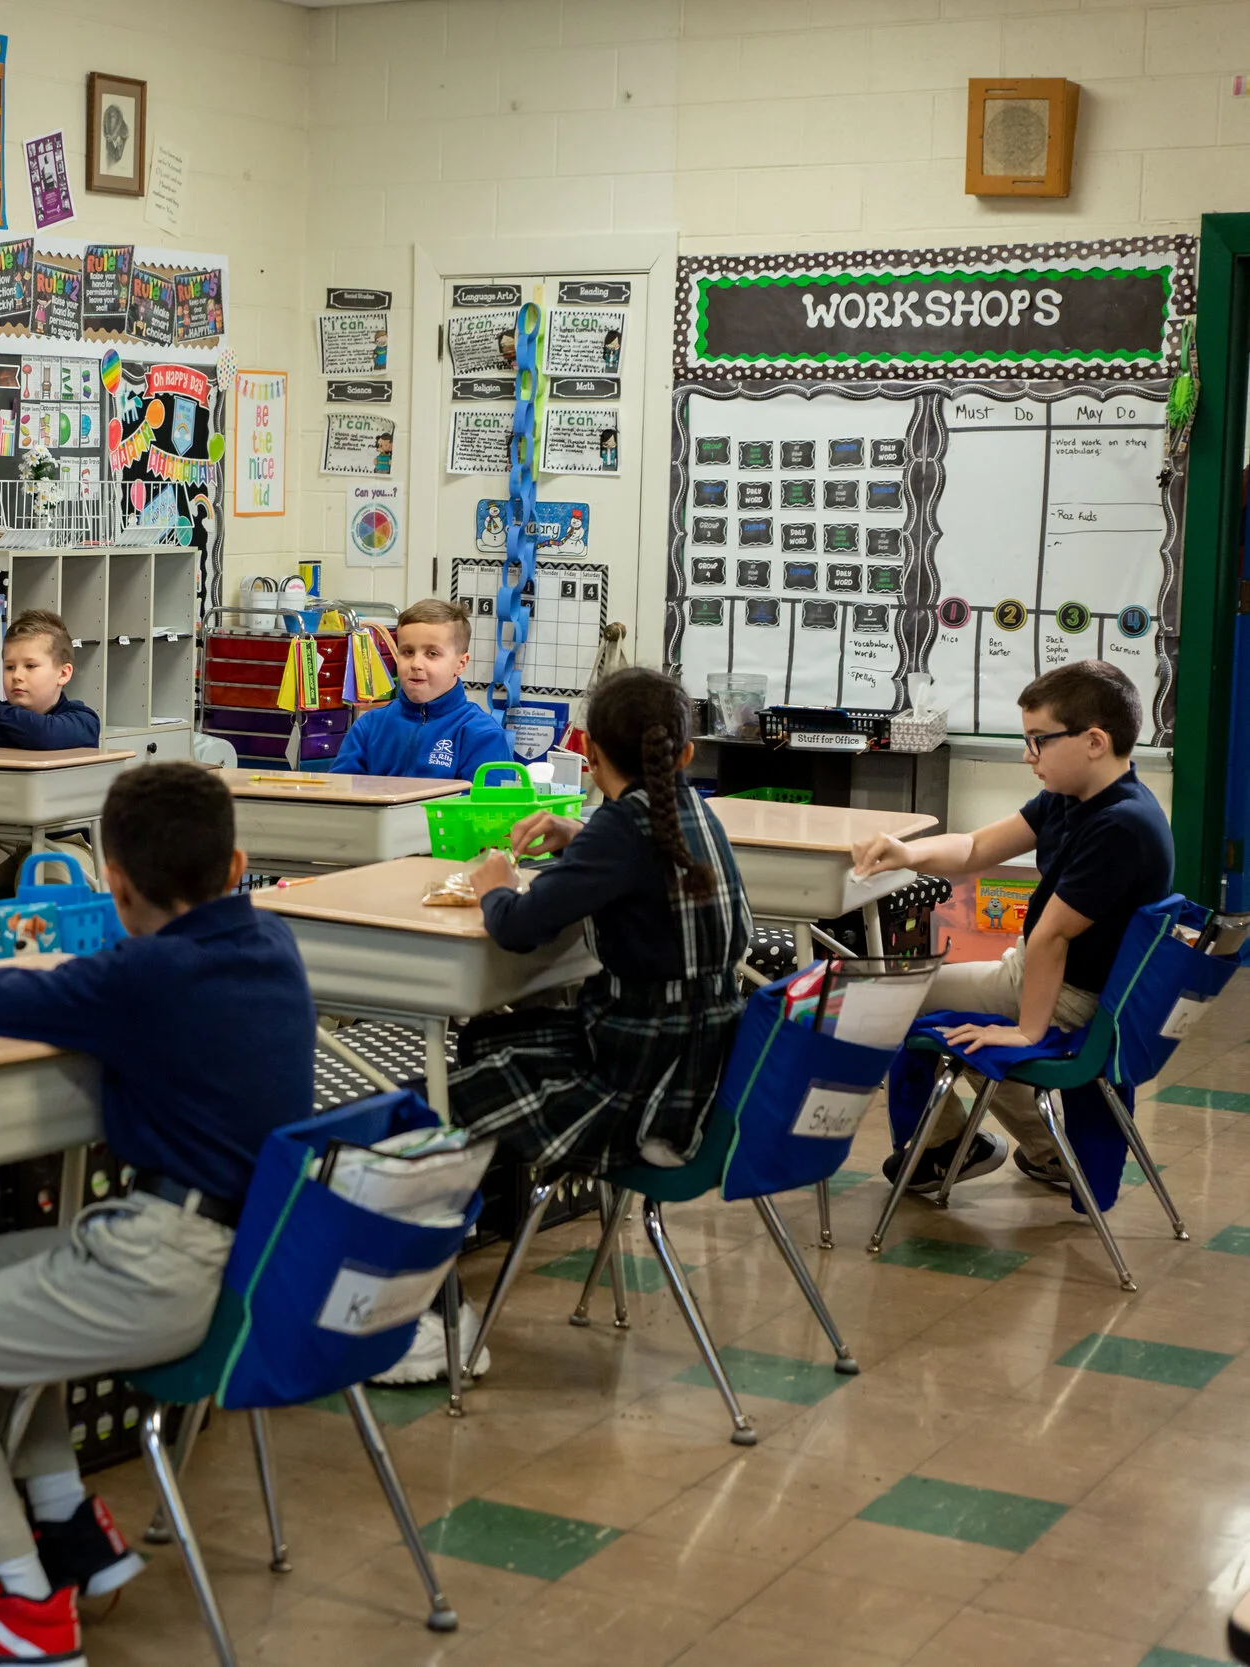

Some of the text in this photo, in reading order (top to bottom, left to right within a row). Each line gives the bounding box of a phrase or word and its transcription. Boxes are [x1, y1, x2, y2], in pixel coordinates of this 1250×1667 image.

[86, 252, 116, 273] Rule
[36, 273, 64, 295] Rule
[133, 278, 161, 301] Rule
[86, 287, 113, 297] permission
[177, 281, 201, 302] Rule
[461, 291, 514, 303] Language Arts
[579, 286, 609, 298] Reading
[152, 305, 170, 318] Make
[802, 288, 1063, 329] WORKSHOPS
[49, 316, 79, 330] permission
[151, 317, 170, 331] smart
[153, 371, 165, 387] Oh
[347, 385, 372, 396] Science
[473, 383, 501, 395] Religion
[575, 381, 595, 391] Math
[255, 404, 269, 428] Be
[955, 404, 1034, 422] Must Do
[1076, 405, 1137, 424] May Do
[251, 431, 273, 454] the
[1081, 438, 1147, 449] work story
[878, 453, 898, 461] WORD
[151, 453, 216, 481] BIRTHDAY
[248, 457, 275, 480] nice
[252, 484, 270, 507] kid
[354, 487, 369, 498] Can
[1057, 509, 1075, 520] Raz
[699, 521, 720, 529] GROUP
[789, 537, 808, 545] WORD
[480, 566, 497, 574] Monday
[540, 568, 559, 577] Thursday
[563, 570, 577, 579] Friday
[582, 571, 601, 579] Saturday
[697, 562, 719, 570] GROUP
[834, 578, 853, 586] WORD
[565, 584, 595, 597] 3 4
[482, 601, 490, 612] 6
[1003, 605, 1141, 631] 2 3 4
[989, 637, 1003, 647] Ben
[1045, 635, 1064, 644] Jack
[1045, 645, 1069, 654] Sophia
[1109, 643, 1141, 656] Carmine
[797, 733, 860, 745] Stuff for Office
[428, 758, 452, 768] School
[979, 886, 1031, 901] Mathemat
